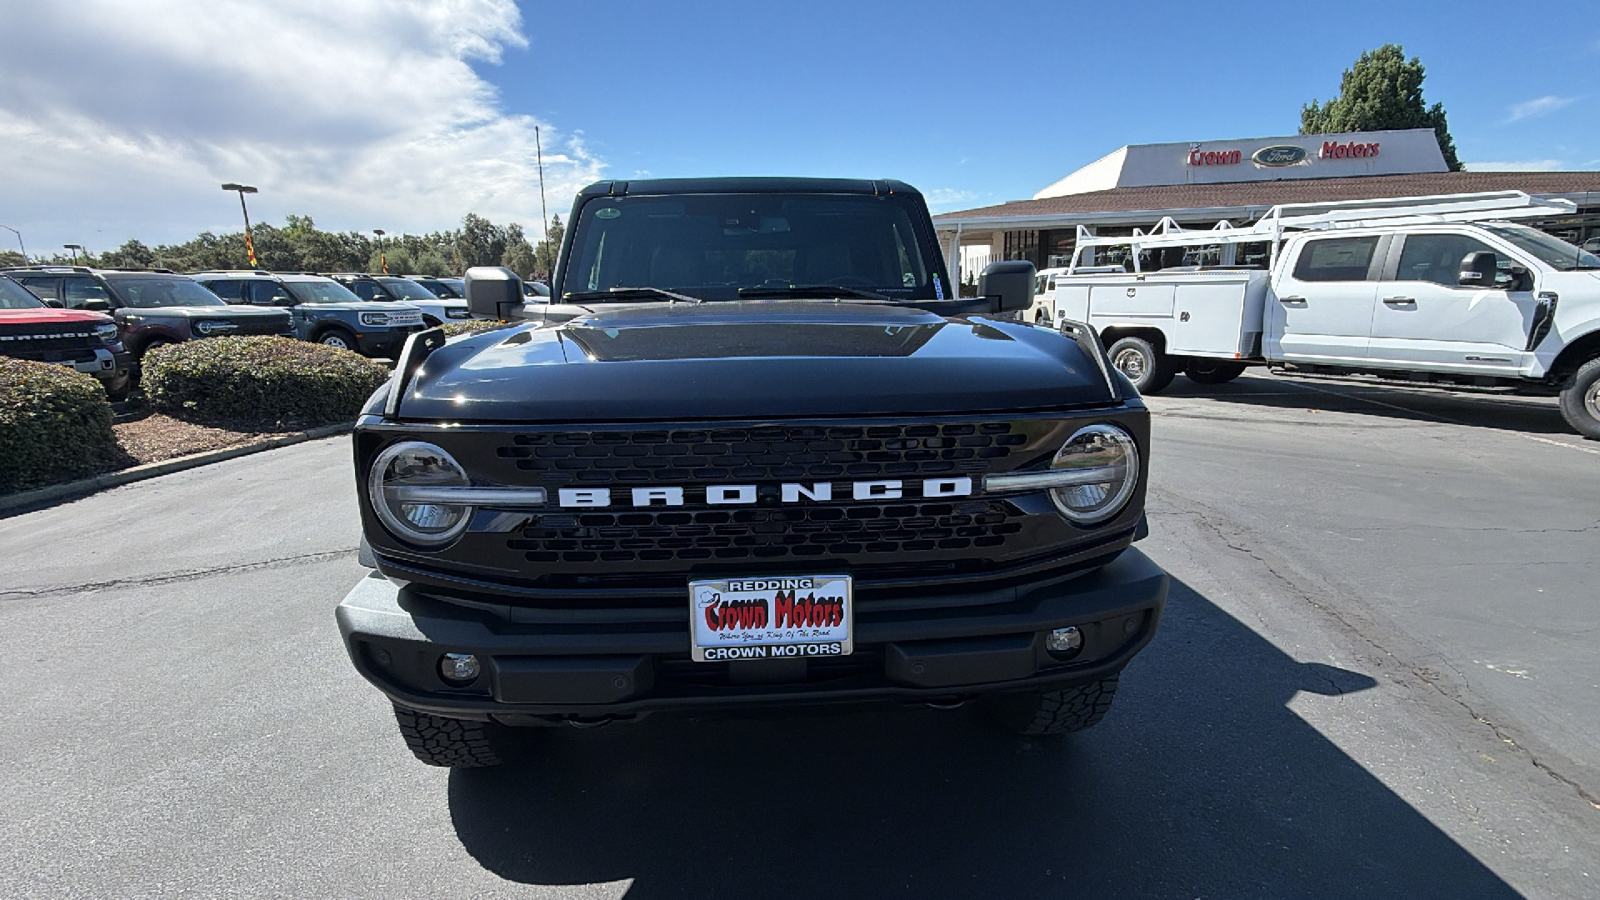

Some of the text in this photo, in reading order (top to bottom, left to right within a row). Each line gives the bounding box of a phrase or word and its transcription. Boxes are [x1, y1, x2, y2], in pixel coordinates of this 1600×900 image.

[1188, 141, 1380, 165] Crown Motors
[1267, 149, 1296, 162] Ford
[558, 477, 972, 507] BRONCO
[730, 579, 813, 592] REDDING
[705, 590, 843, 631] Crown Motors
[718, 632, 741, 640] Where
[767, 631, 783, 640] King
[785, 630, 794, 639] Of
[797, 629, 809, 637] The
[812, 629, 830, 637] Road
[704, 643, 841, 660] CROWN MOTORS
